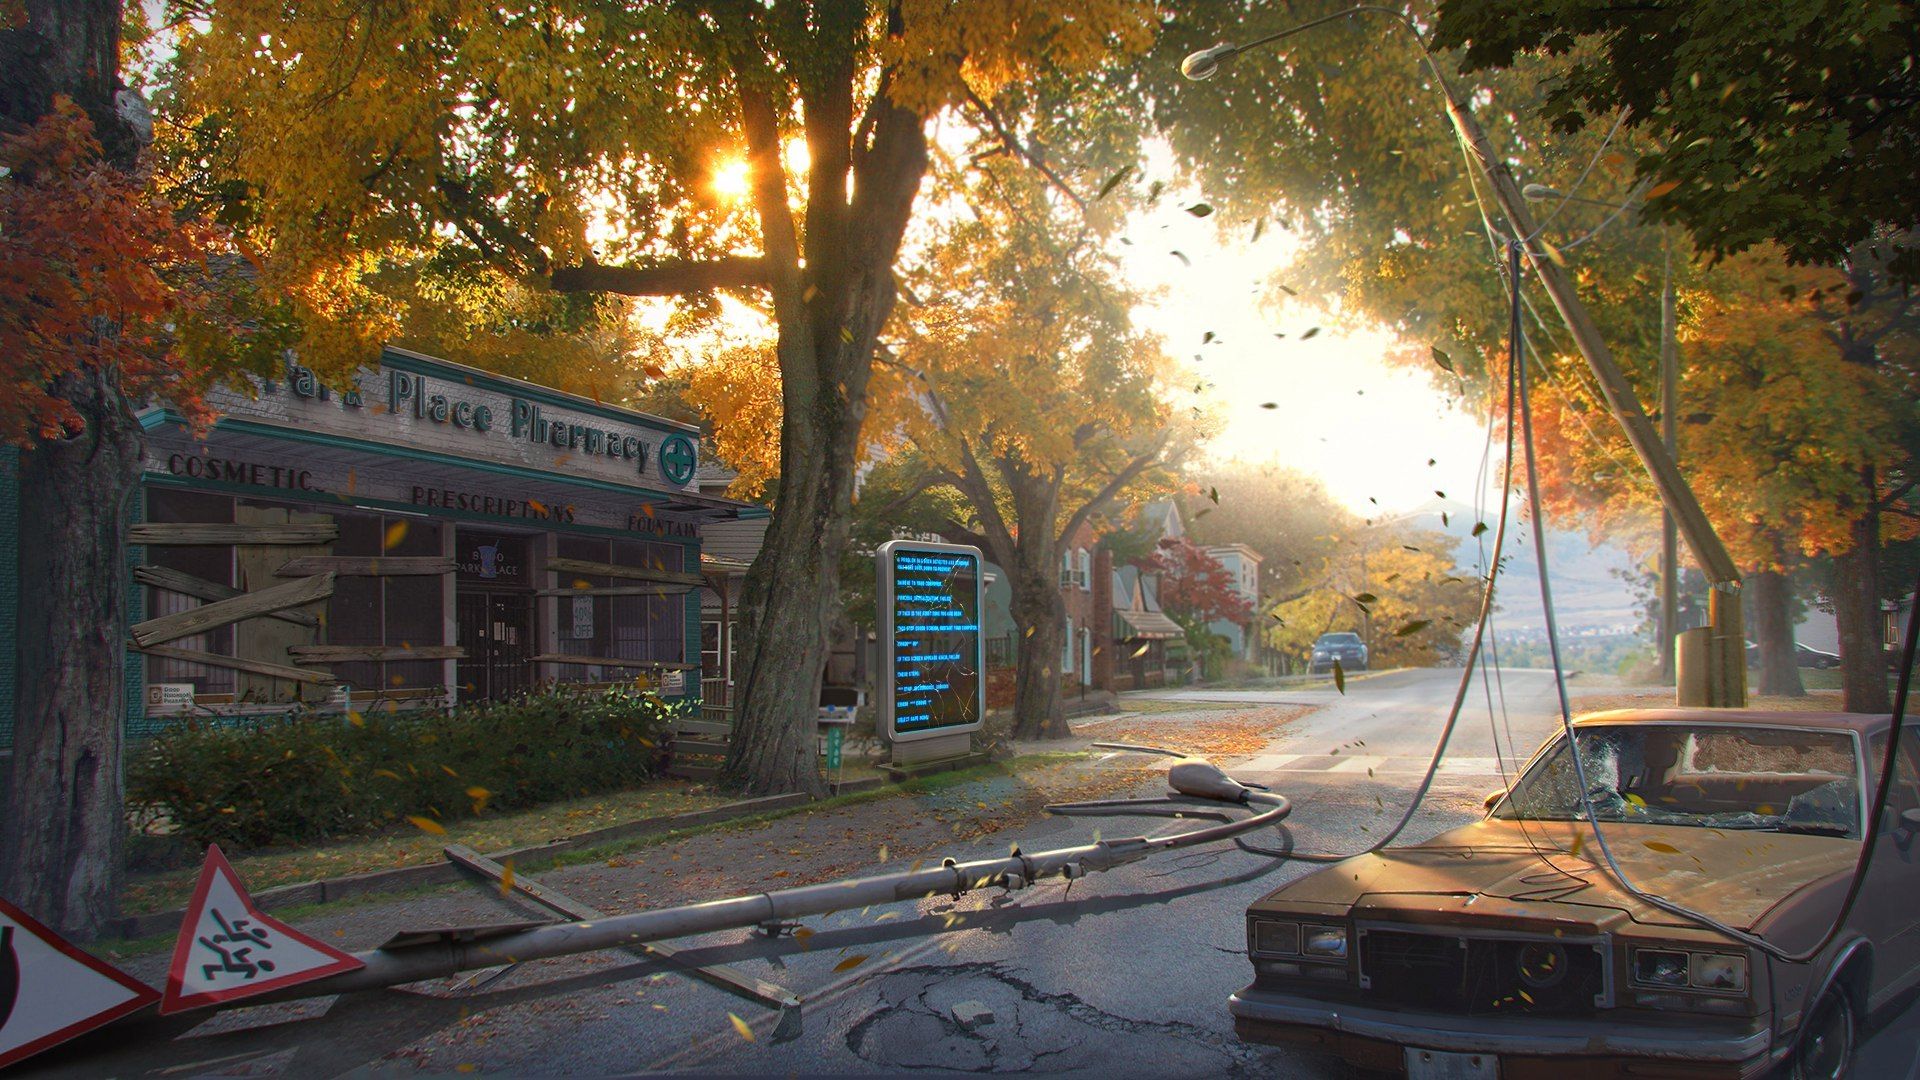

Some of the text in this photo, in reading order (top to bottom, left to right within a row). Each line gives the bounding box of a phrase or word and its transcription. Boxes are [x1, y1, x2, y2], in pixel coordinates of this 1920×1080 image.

[390, 370, 493, 431] Place
[512, 399, 650, 473] Pharmacy
[170, 453, 324, 492] COSMETIC
[628, 515, 698, 538] FOUNTAIN
[575, 606, 591, 621] 40%
[575, 624, 591, 637] OFF
